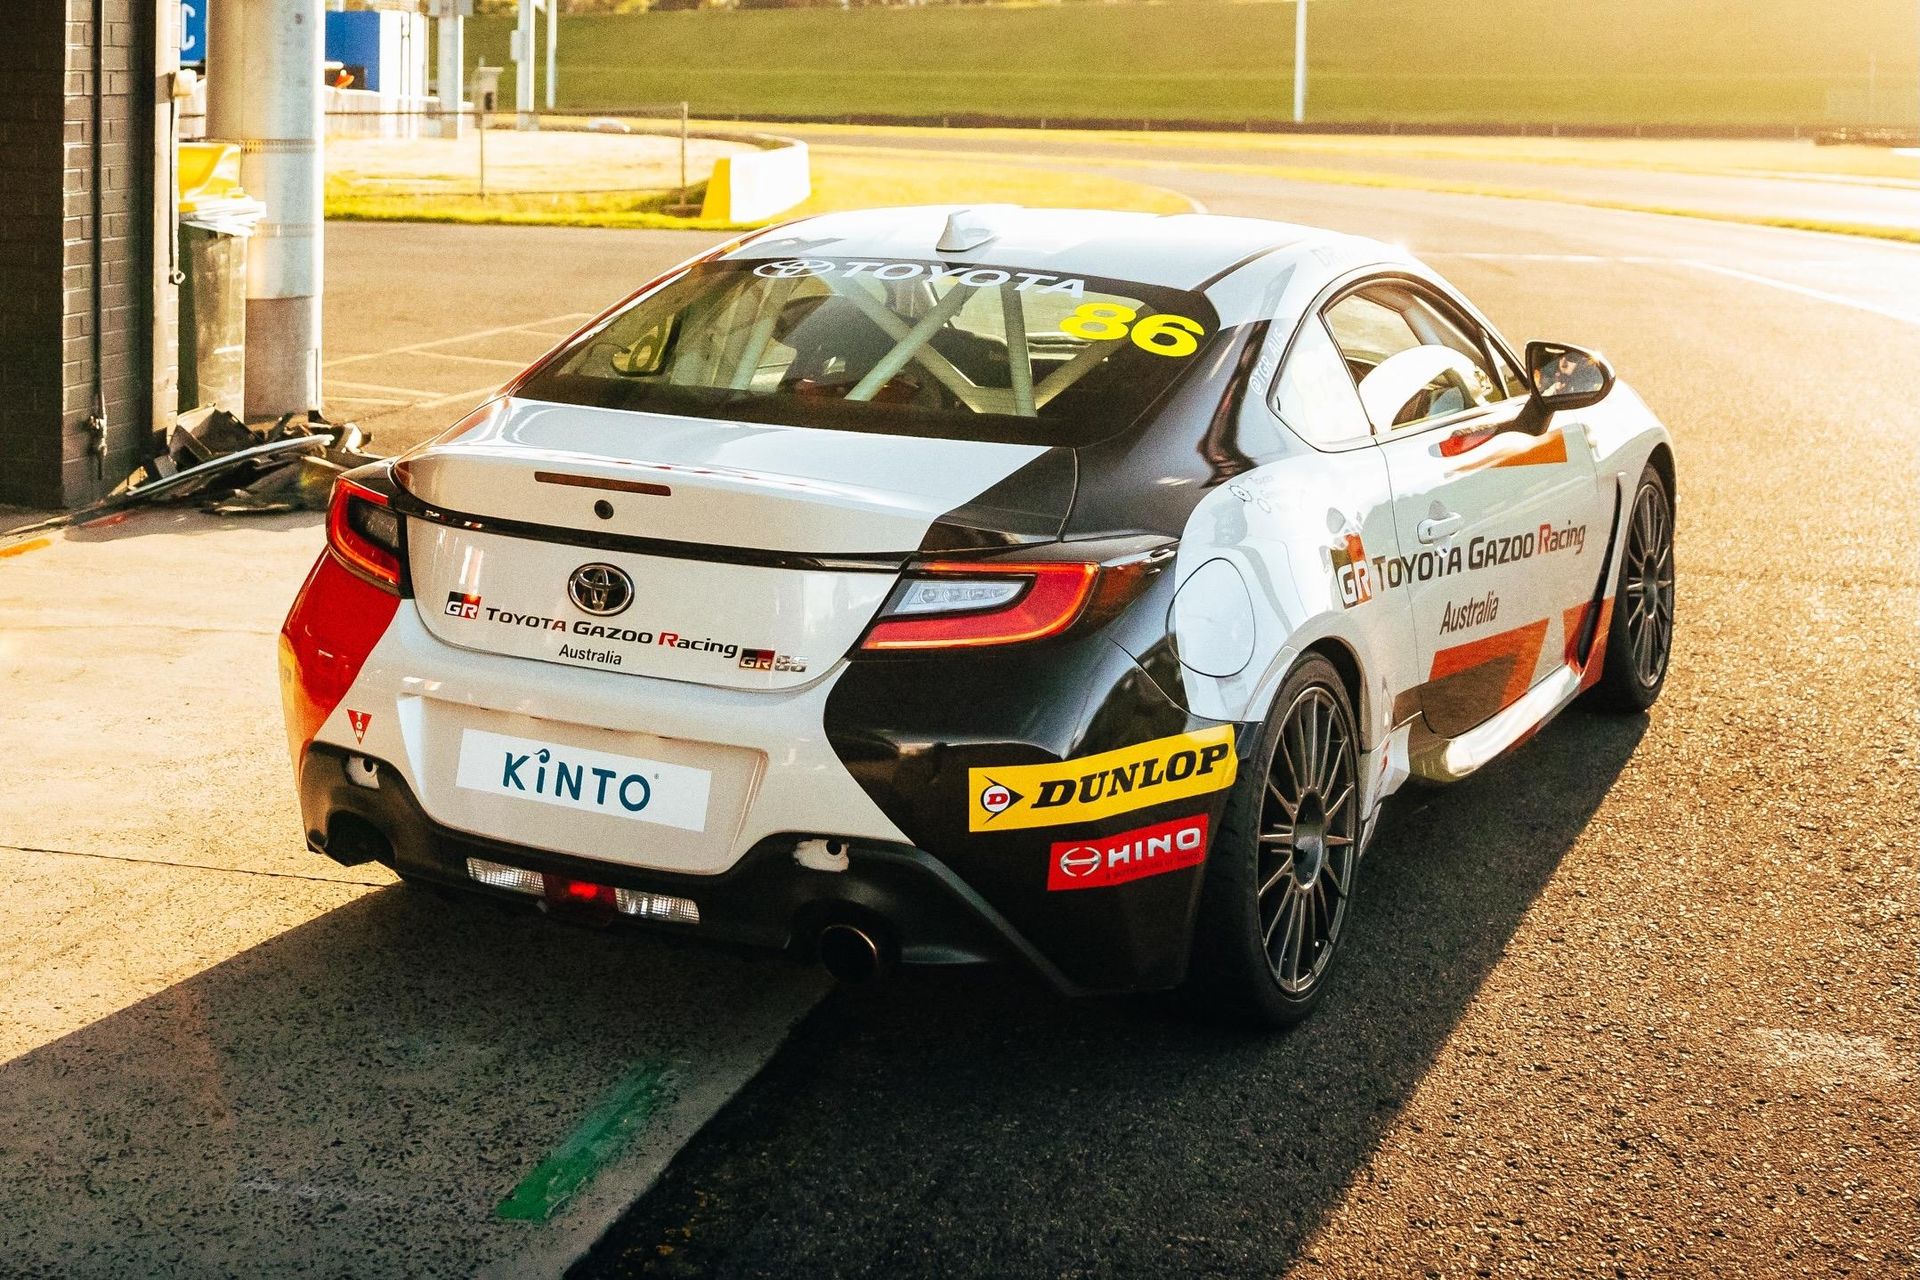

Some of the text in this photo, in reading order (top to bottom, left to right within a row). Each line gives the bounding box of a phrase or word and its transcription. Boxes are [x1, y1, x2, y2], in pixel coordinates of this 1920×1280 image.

[840, 260, 1086, 298] TOYOTA
[1060, 303, 1205, 357] 86
[1337, 519, 1587, 604] GR TOYOTA GAZOO Racing
[446, 601, 738, 659] GR TOYOTA GAZOO Racing
[1439, 591, 1500, 635] Australia
[558, 643, 622, 666] Australia
[1030, 743, 1229, 808] DUNLOP
[1107, 827, 1202, 868] HINO
